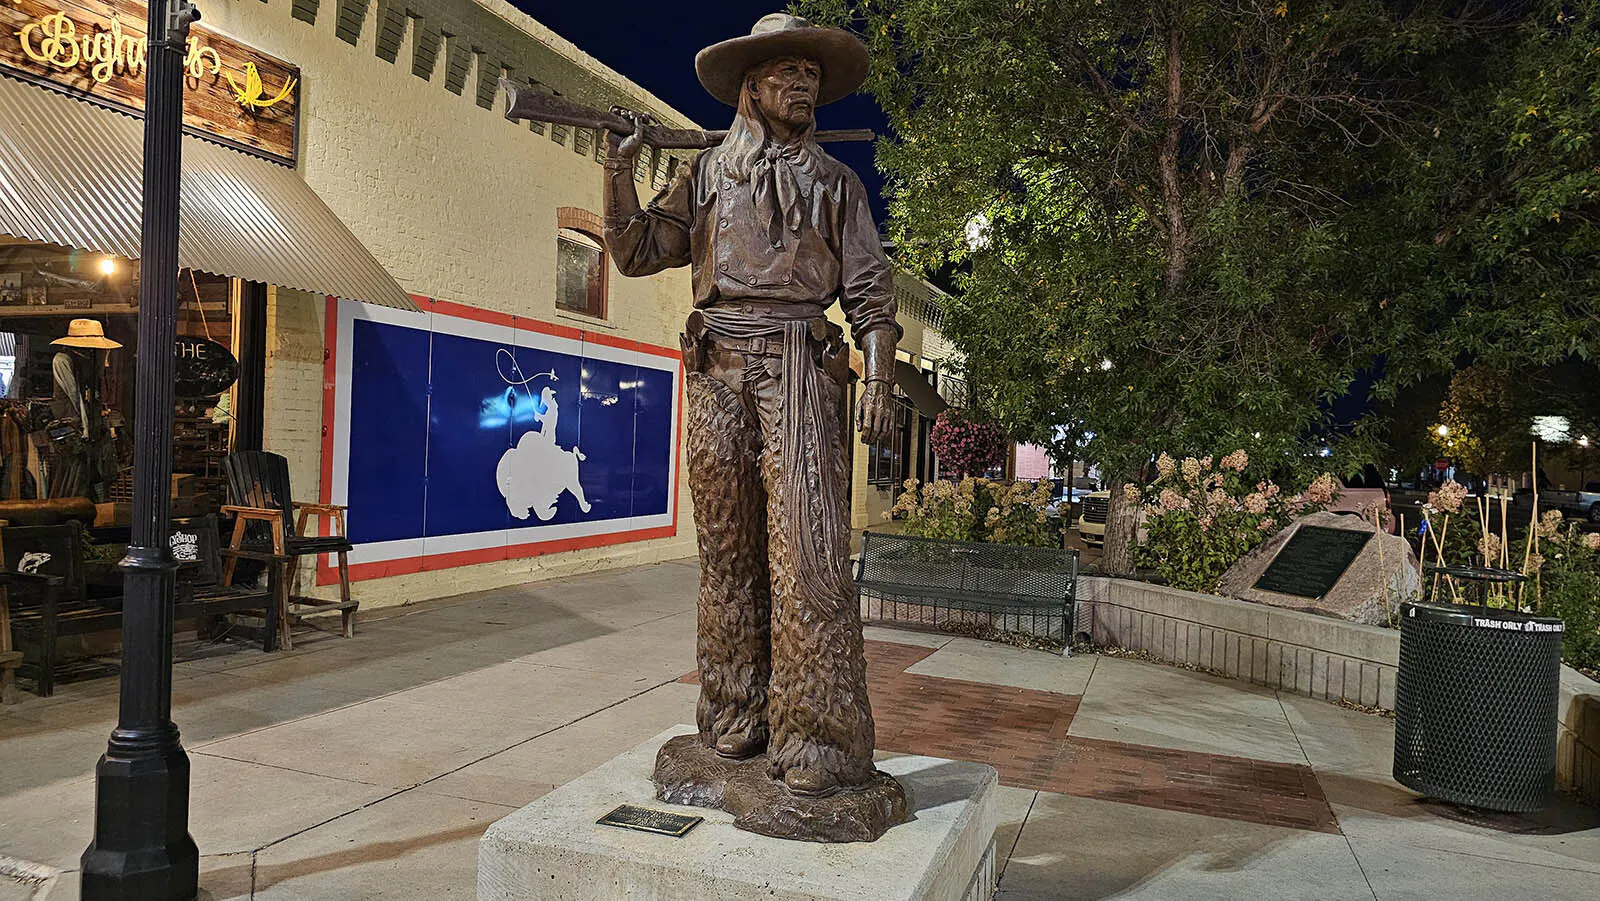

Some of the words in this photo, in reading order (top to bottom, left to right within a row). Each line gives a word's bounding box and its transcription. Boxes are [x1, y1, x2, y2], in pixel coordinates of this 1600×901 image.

[13, 11, 221, 83] Bighos
[174, 342, 206, 359] THE
[1474, 618, 1502, 629] TRASH
[1502, 620, 1523, 631] ONLY
